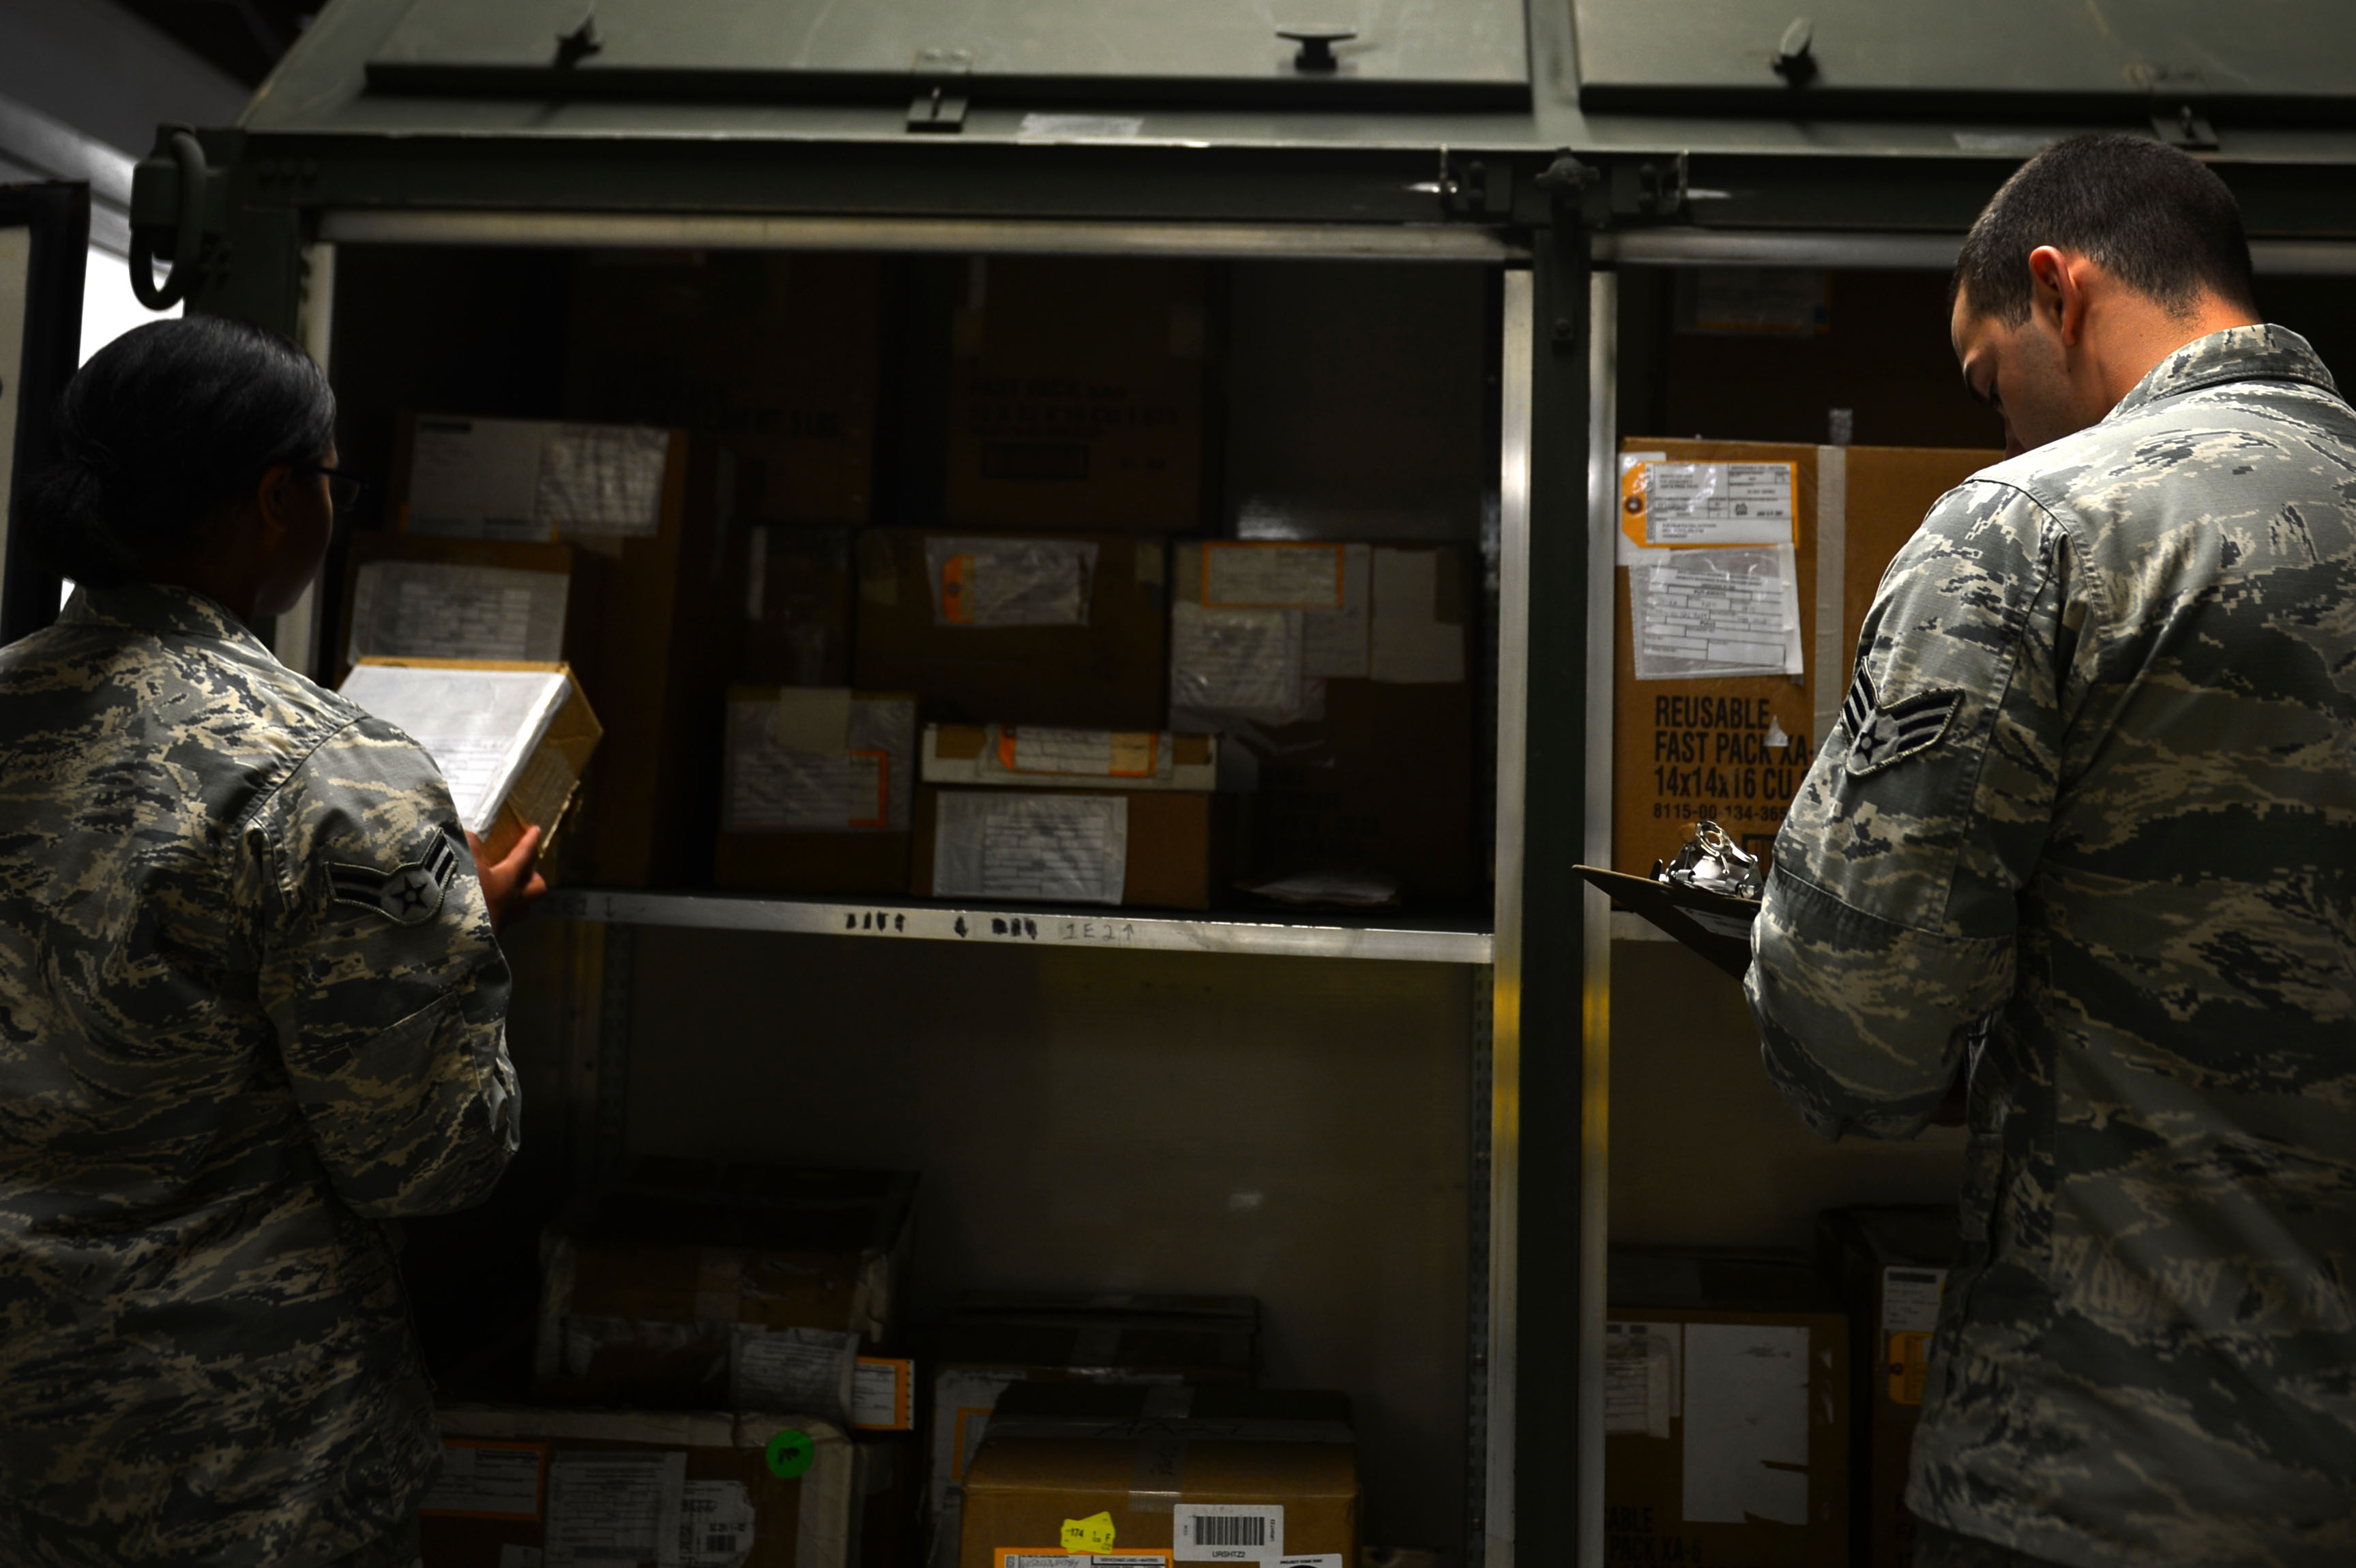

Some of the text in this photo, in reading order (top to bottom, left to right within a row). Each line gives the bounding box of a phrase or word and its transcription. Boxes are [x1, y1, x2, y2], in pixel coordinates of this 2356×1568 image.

[1655, 695, 1770, 730] REUSABLE
[1655, 730, 1709, 763] FAST
[1716, 733, 1772, 765] PACK
[1654, 765, 1792, 800] 14x14x16 CU
[1604, 1506, 1653, 1533] ABLE
[1610, 1535, 1655, 1562] PACK
